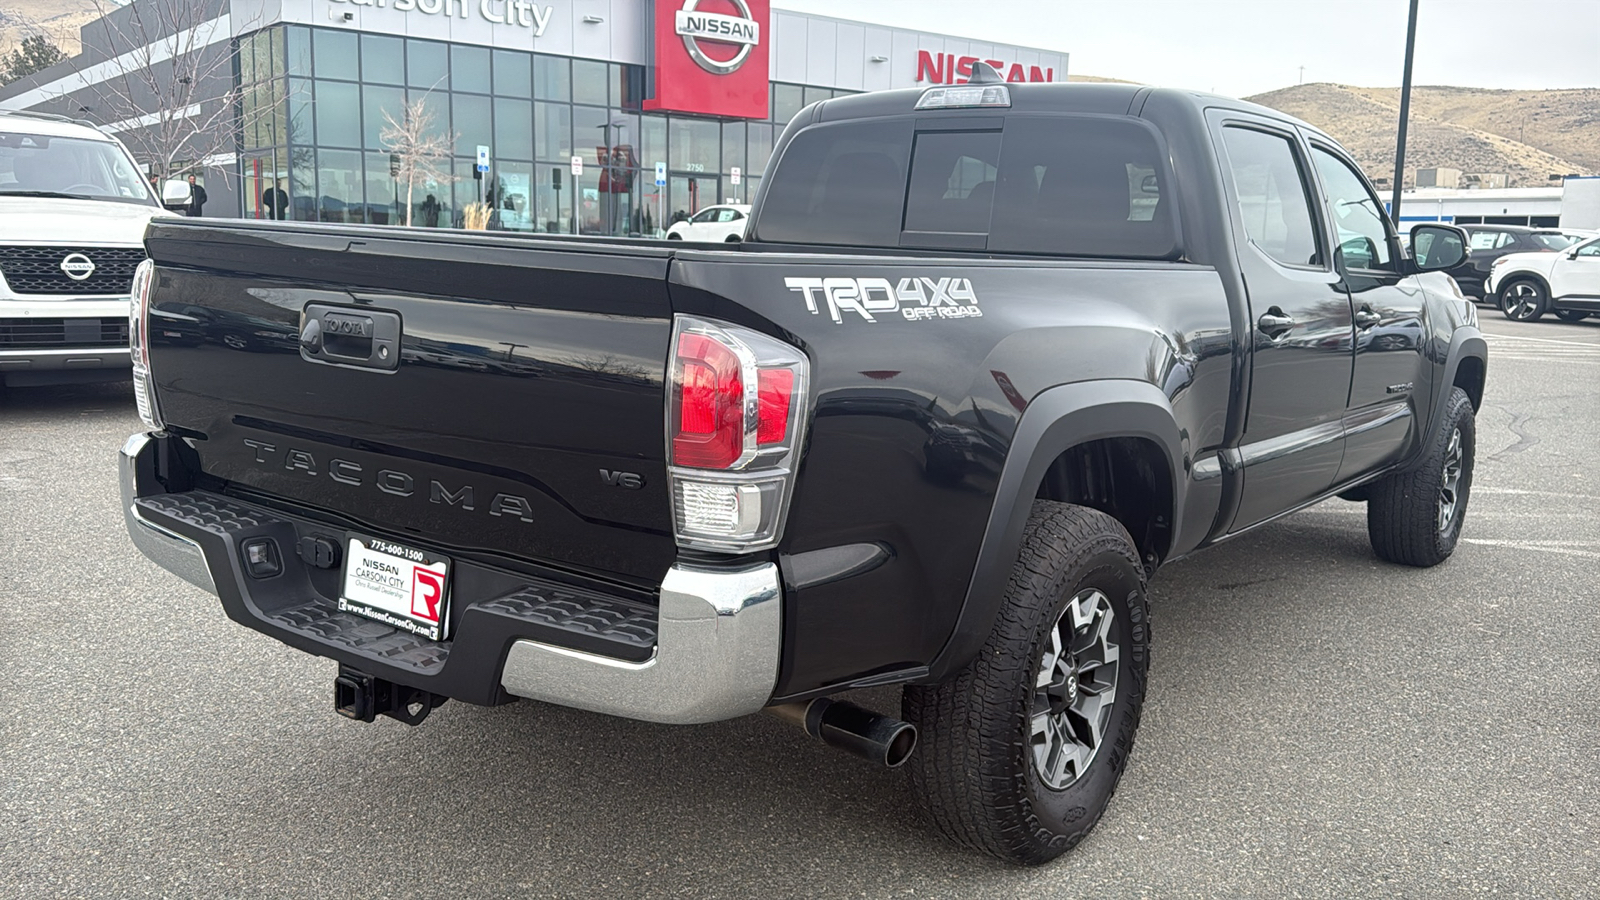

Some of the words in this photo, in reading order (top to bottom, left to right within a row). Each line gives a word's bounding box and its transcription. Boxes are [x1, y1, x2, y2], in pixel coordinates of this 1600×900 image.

[333, 0, 469, 19] son
[480, 0, 553, 37] City
[687, 16, 754, 39] NISSAN
[686, 163, 704, 172] 2750
[784, 277, 899, 324] TRD
[902, 307, 937, 321] OFF
[937, 305, 983, 319] ROAD
[324, 318, 366, 336] TOYOTA
[244, 439, 533, 522] TACOMA
[599, 469, 641, 490] V6
[370, 540, 424, 561] 775-600-1500
[356, 567, 386, 583] CARSON
[388, 577, 405, 588] CITY
[362, 558, 399, 576] NISSAN
[347, 603, 430, 637] www.NissanCarsonCity.com
